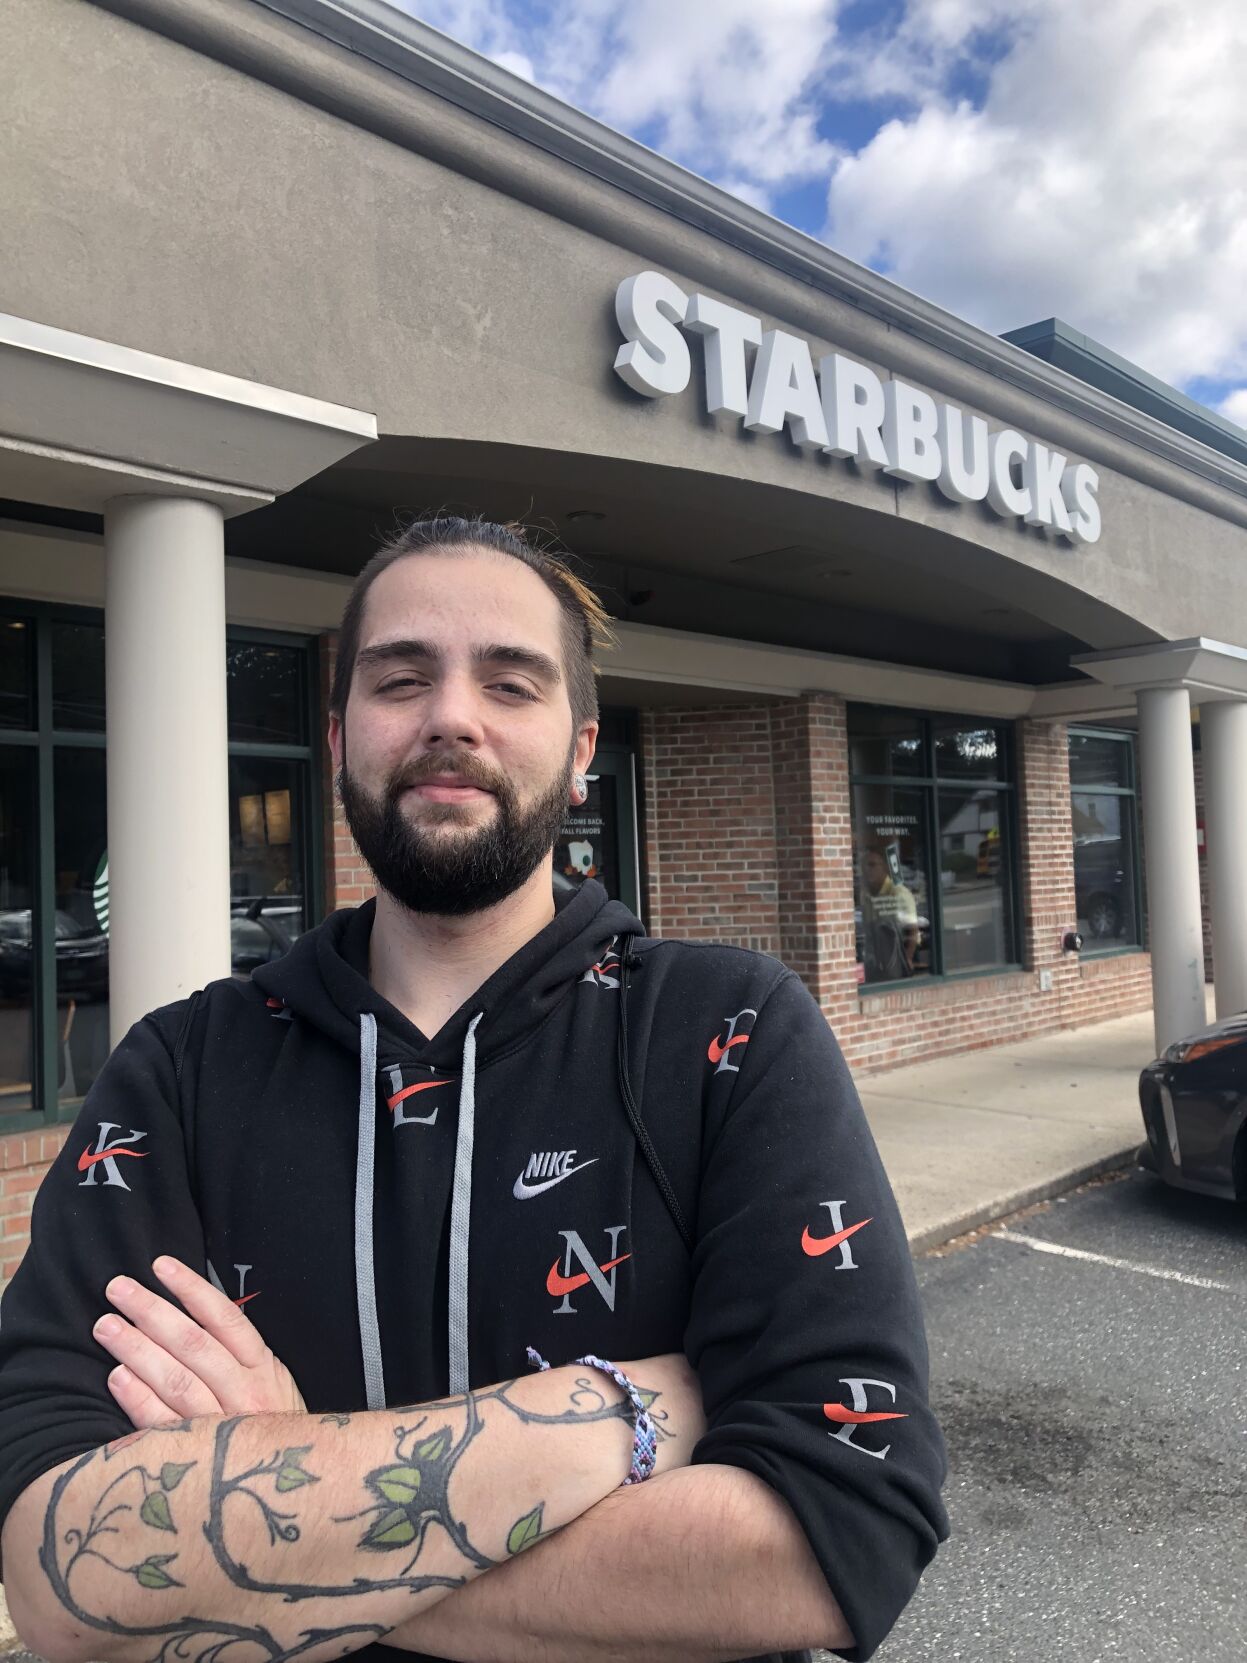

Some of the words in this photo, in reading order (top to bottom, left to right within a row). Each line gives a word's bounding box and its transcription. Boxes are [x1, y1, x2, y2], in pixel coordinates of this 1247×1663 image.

[614, 270, 1101, 544] STARBUCKS
[78, 1122, 148, 1192] K
[524, 1149, 578, 1179] NIKE
[552, 1225, 627, 1314] N
